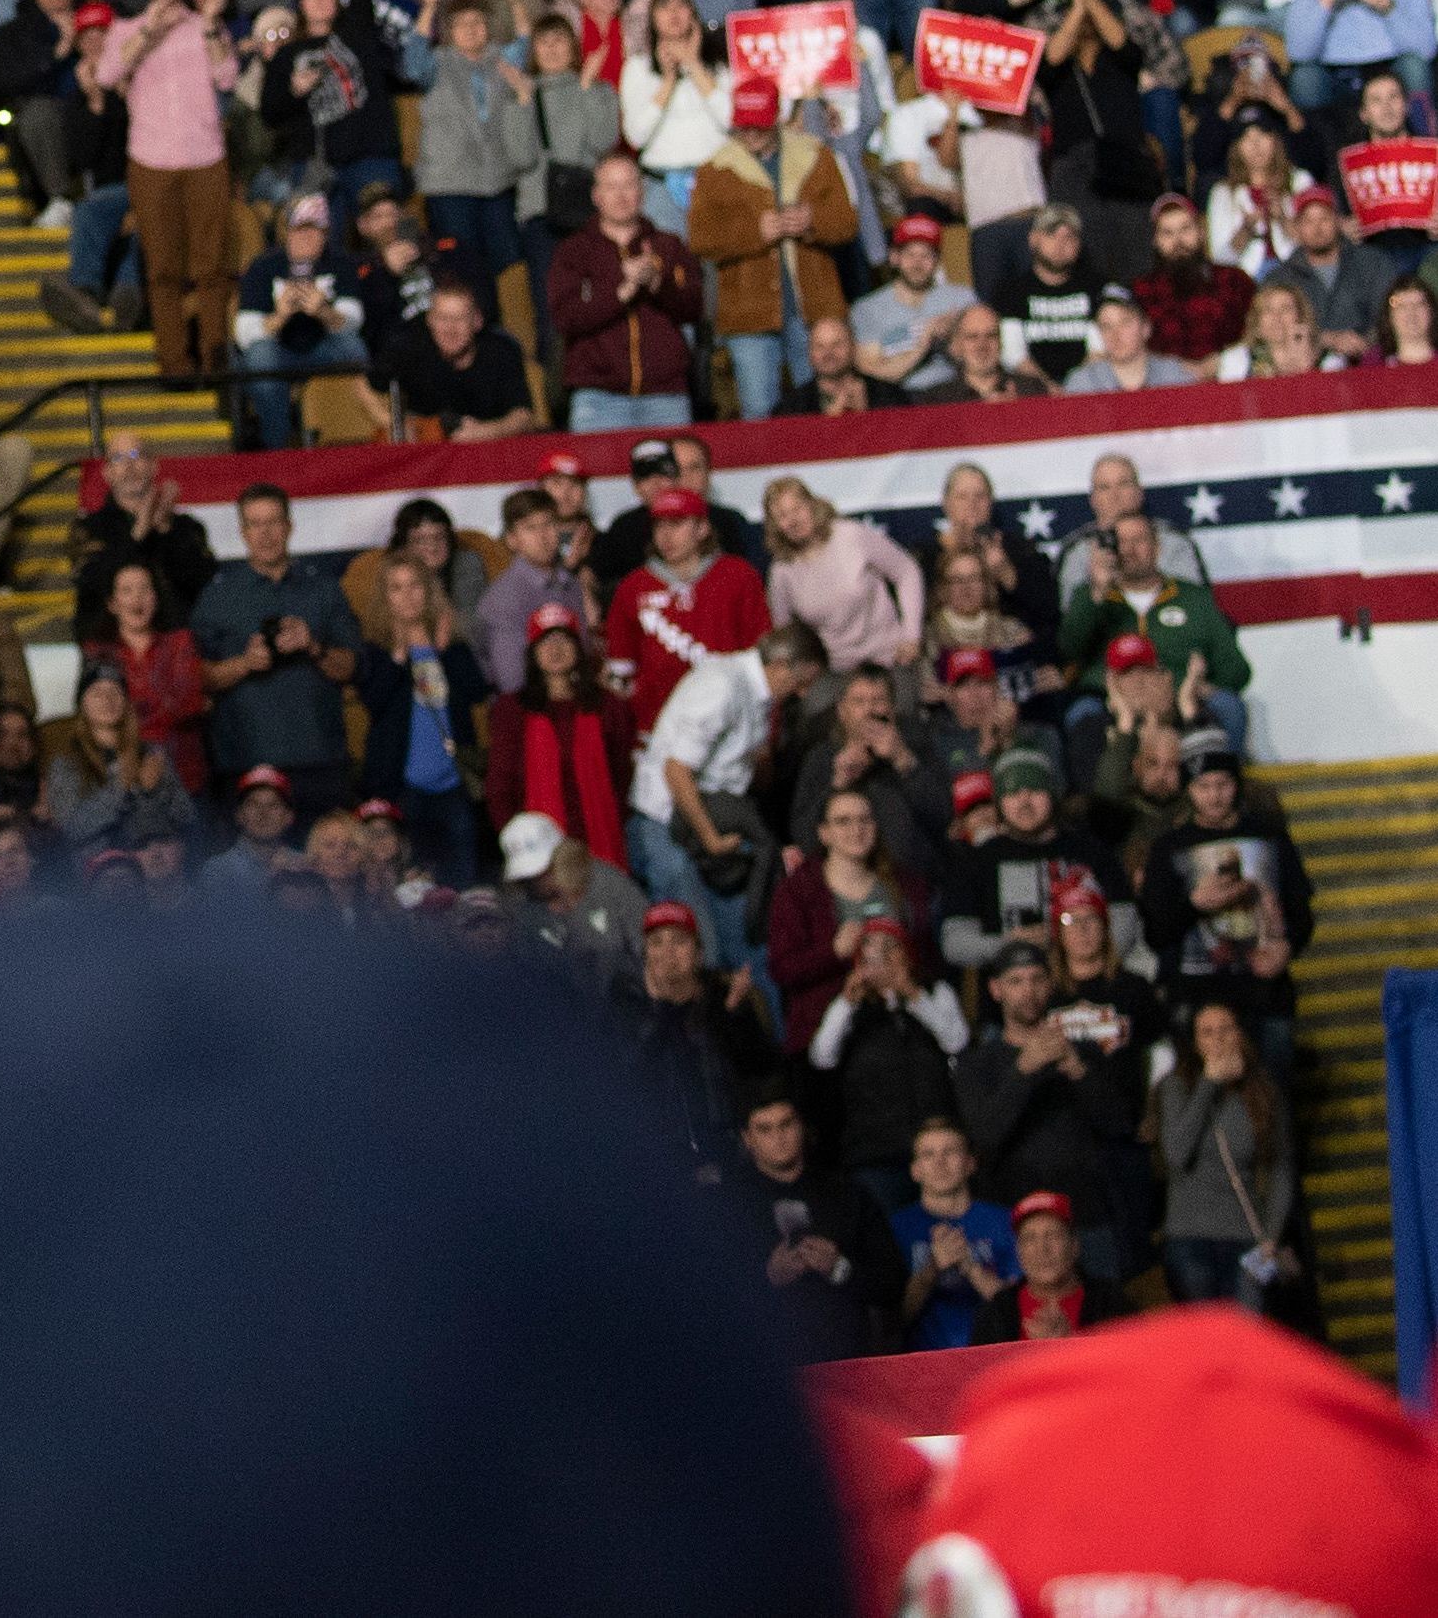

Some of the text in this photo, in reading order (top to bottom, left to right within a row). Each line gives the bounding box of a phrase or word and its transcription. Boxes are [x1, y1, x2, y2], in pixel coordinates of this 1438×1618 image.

[737, 25, 846, 55] TRUMP
[925, 33, 1029, 67] TRUMP
[1349, 162, 1435, 187] TRUMP
